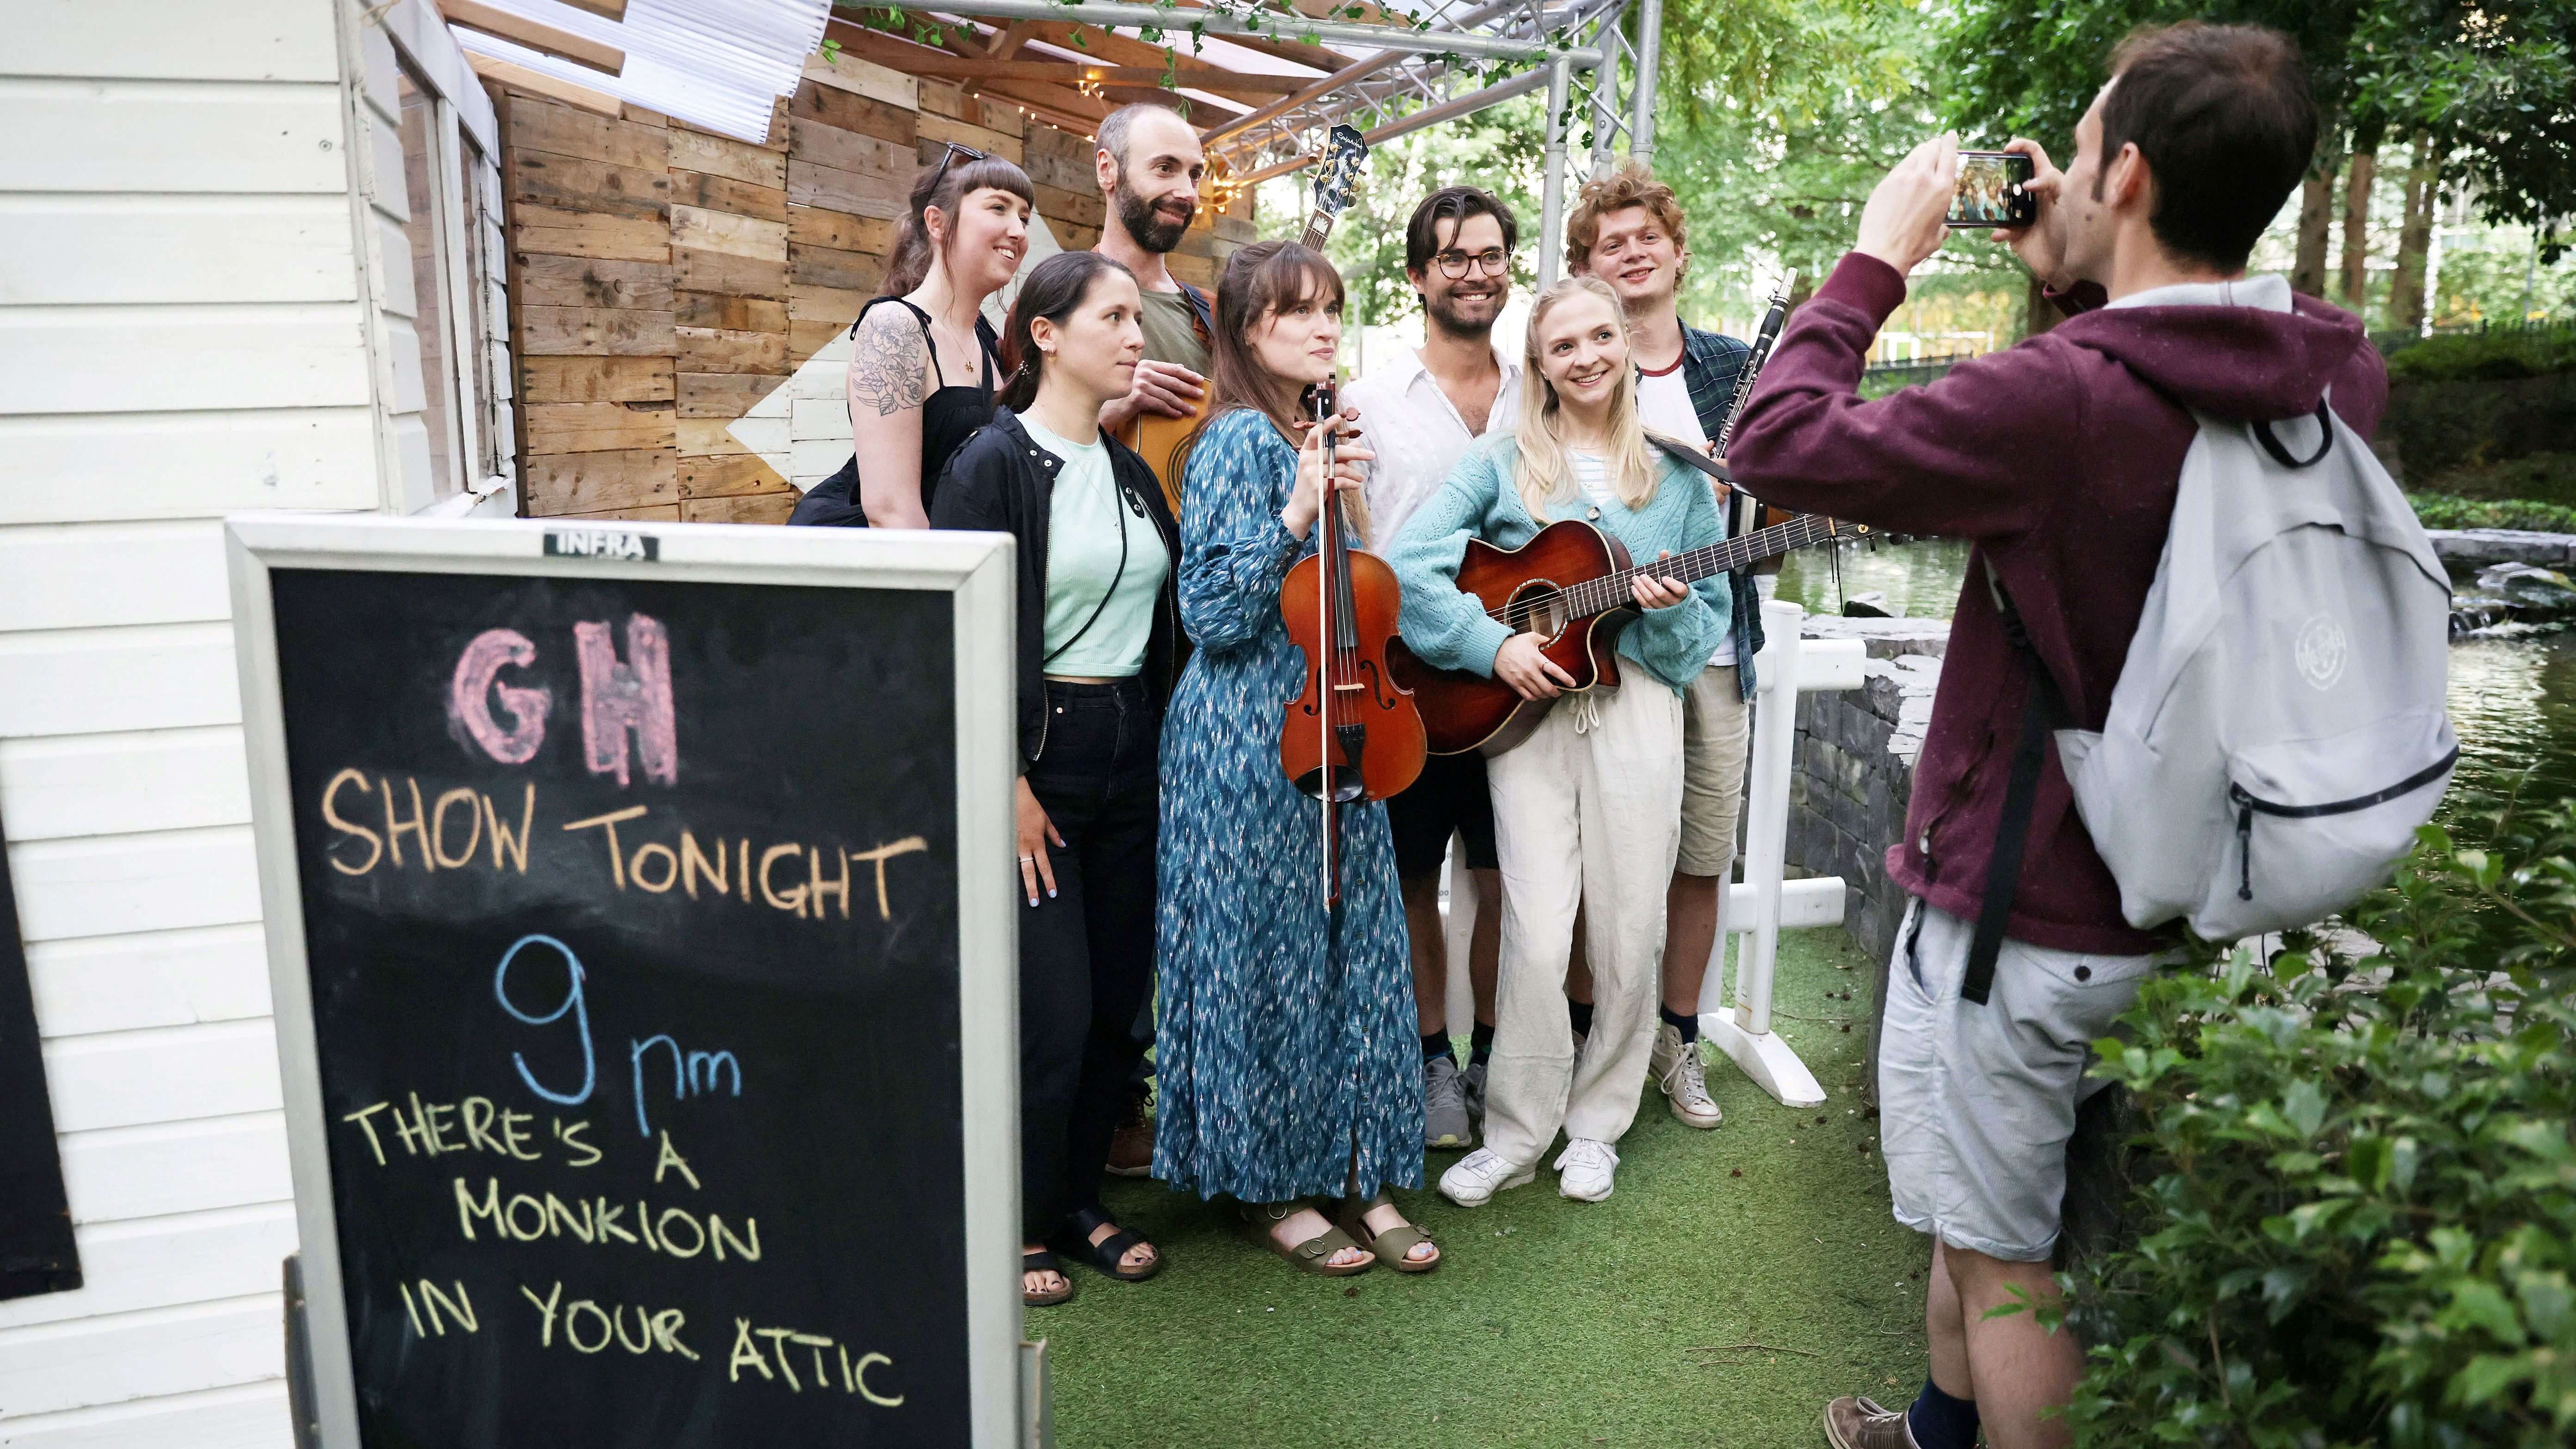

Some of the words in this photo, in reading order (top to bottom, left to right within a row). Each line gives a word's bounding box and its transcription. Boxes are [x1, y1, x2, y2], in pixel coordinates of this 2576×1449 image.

[1336, 132, 1362, 149] Epiphone
[556, 531, 646, 560] INFRA
[323, 768, 534, 875] SHOW
[563, 806, 926, 919] TONIGHT
[495, 934, 595, 1105] 9
[343, 1091, 602, 1167] THERE'S
[655, 1131, 700, 1189] A
[454, 1176, 761, 1261] MONKION
[400, 1278, 479, 1338] IN
[521, 1281, 700, 1361] YOUR
[730, 1316, 904, 1407] ATTIC
